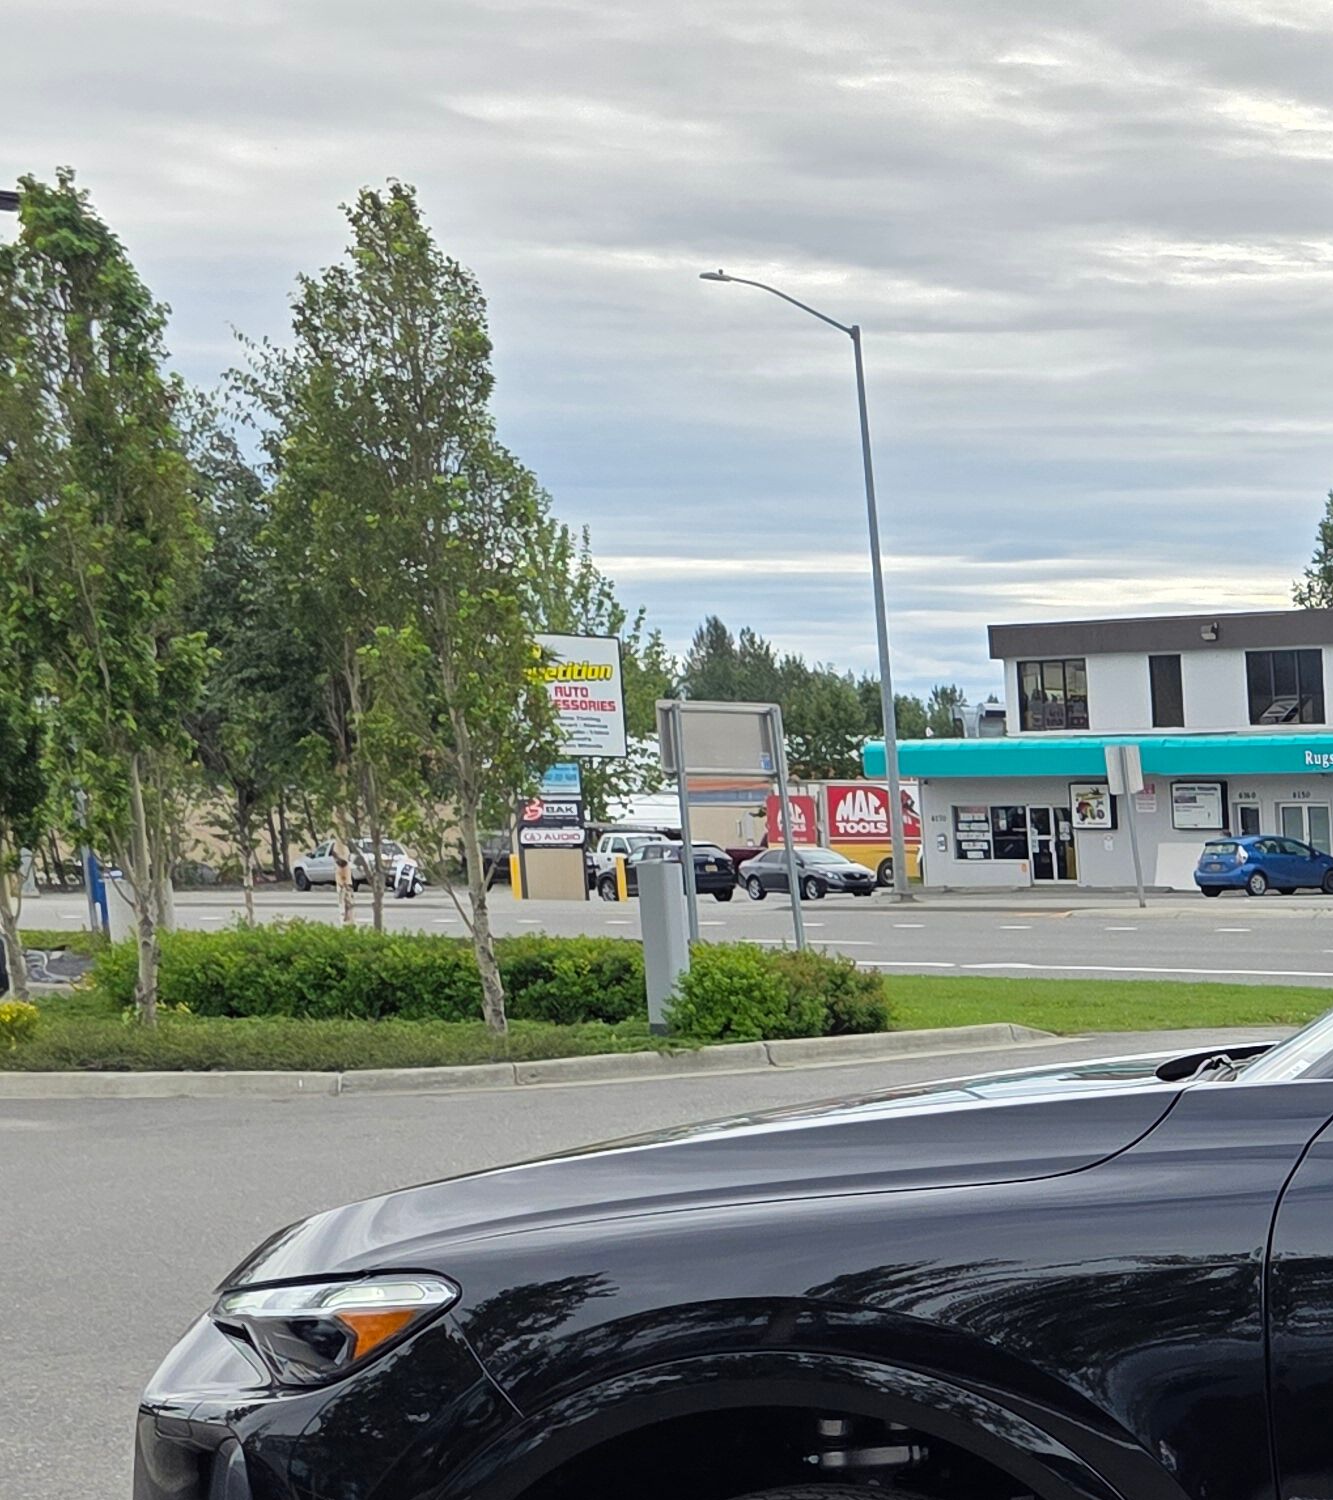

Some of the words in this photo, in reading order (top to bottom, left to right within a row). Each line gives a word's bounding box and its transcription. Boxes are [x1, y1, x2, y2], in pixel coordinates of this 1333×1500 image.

[554, 686, 589, 697] AUTO
[836, 789, 887, 821] MAC
[836, 822, 888, 833] TOOLS
